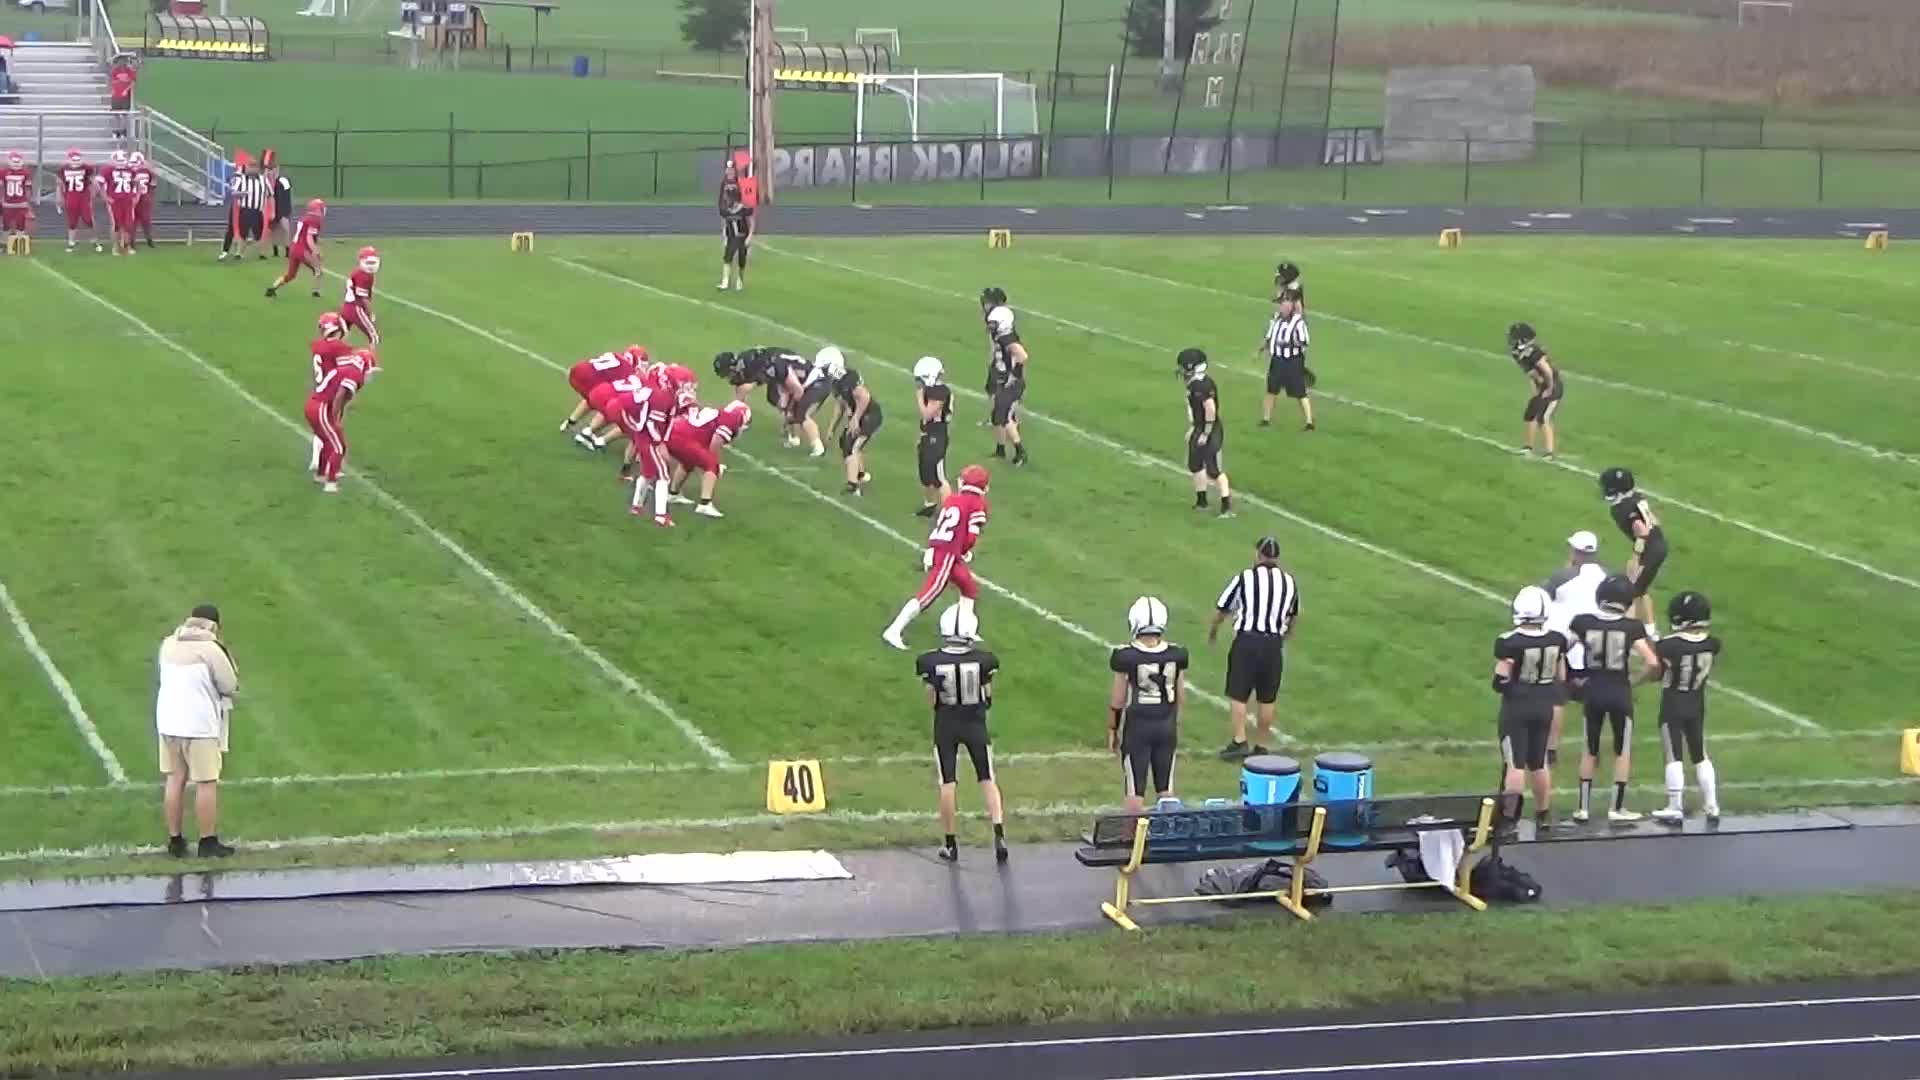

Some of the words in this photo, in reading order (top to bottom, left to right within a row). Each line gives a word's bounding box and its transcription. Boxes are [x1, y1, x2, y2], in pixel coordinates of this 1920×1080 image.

[65, 175, 84, 192] 75
[935, 663, 981, 706] 30
[1136, 661, 1178, 705] 51
[783, 763, 815, 803] 40
